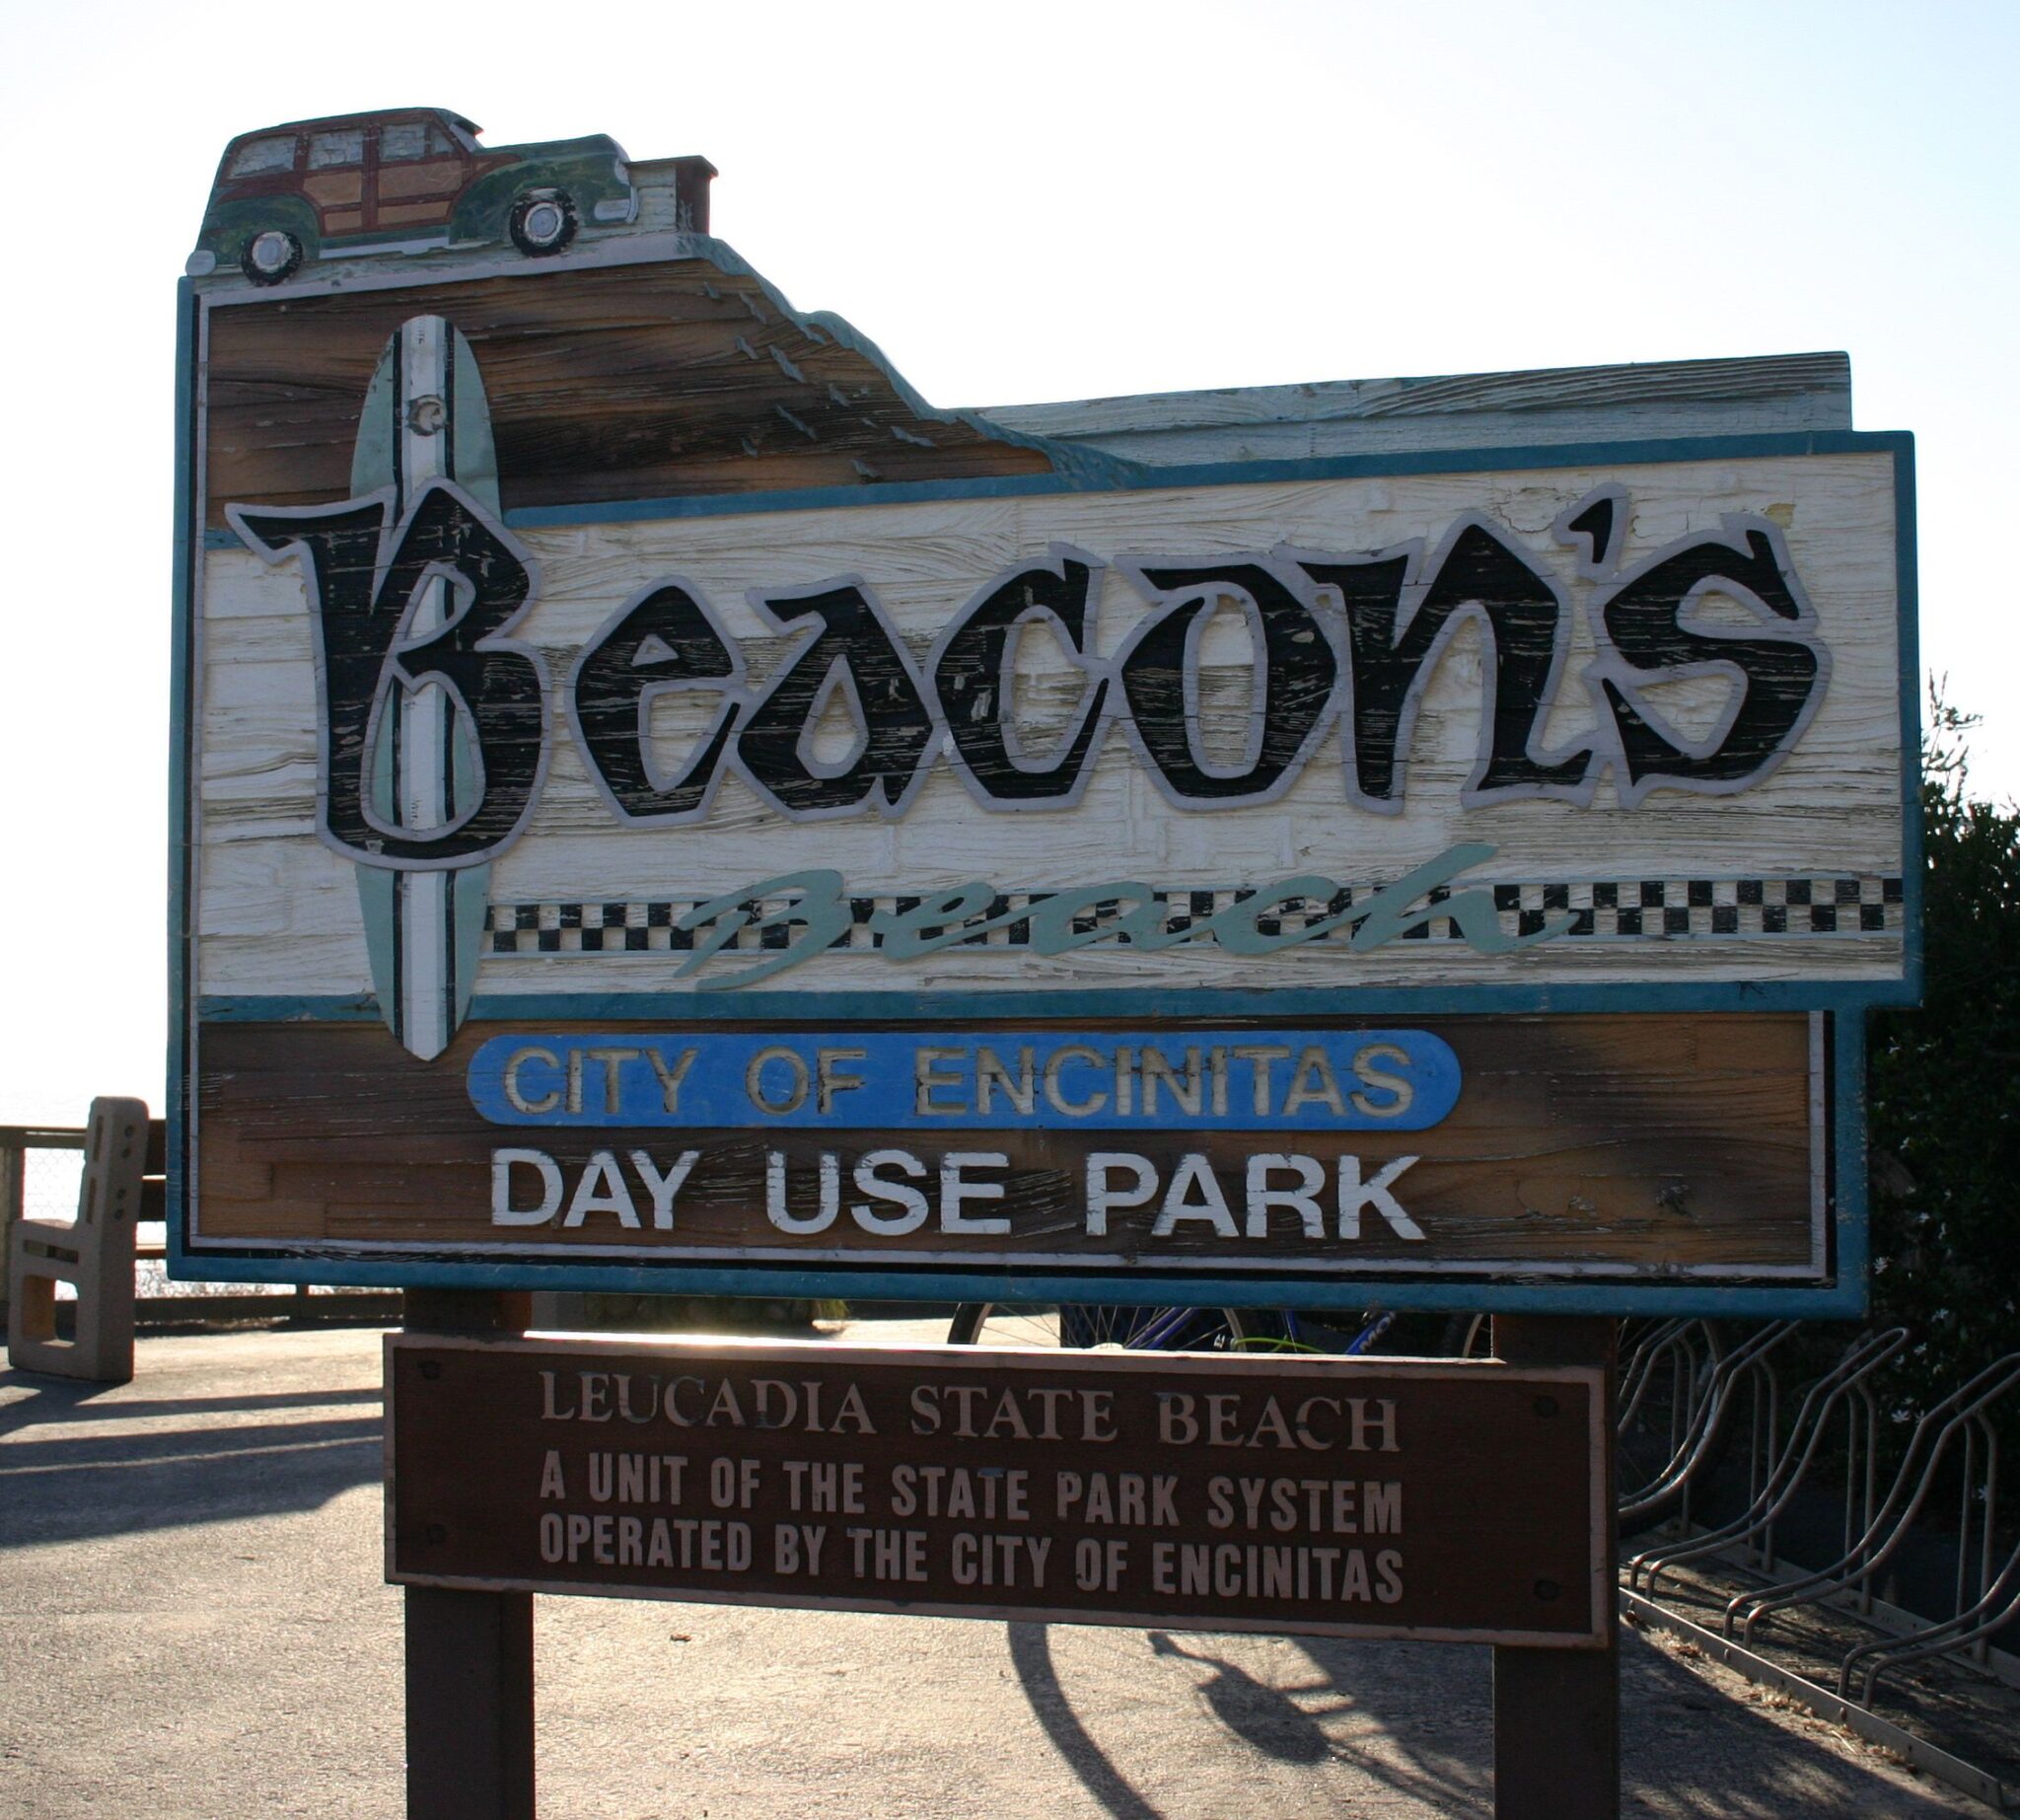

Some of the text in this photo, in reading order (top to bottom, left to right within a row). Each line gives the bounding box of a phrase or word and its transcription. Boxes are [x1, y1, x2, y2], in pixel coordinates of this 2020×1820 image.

[224, 475, 1835, 871] Beacon's
[671, 841, 1580, 987] Beach
[503, 1044, 1414, 1118] CITY OF ENCINITAS
[492, 1147, 1427, 1241] DAY USE PARK
[539, 1370, 1402, 1453] LEUCADIA STATE BEACH
[540, 1449, 1403, 1535] A UNIT OF THE STATE PARK SYSTEM
[540, 1512, 1405, 1605] OPERATED BY THE CITY OF ENCINITAS
